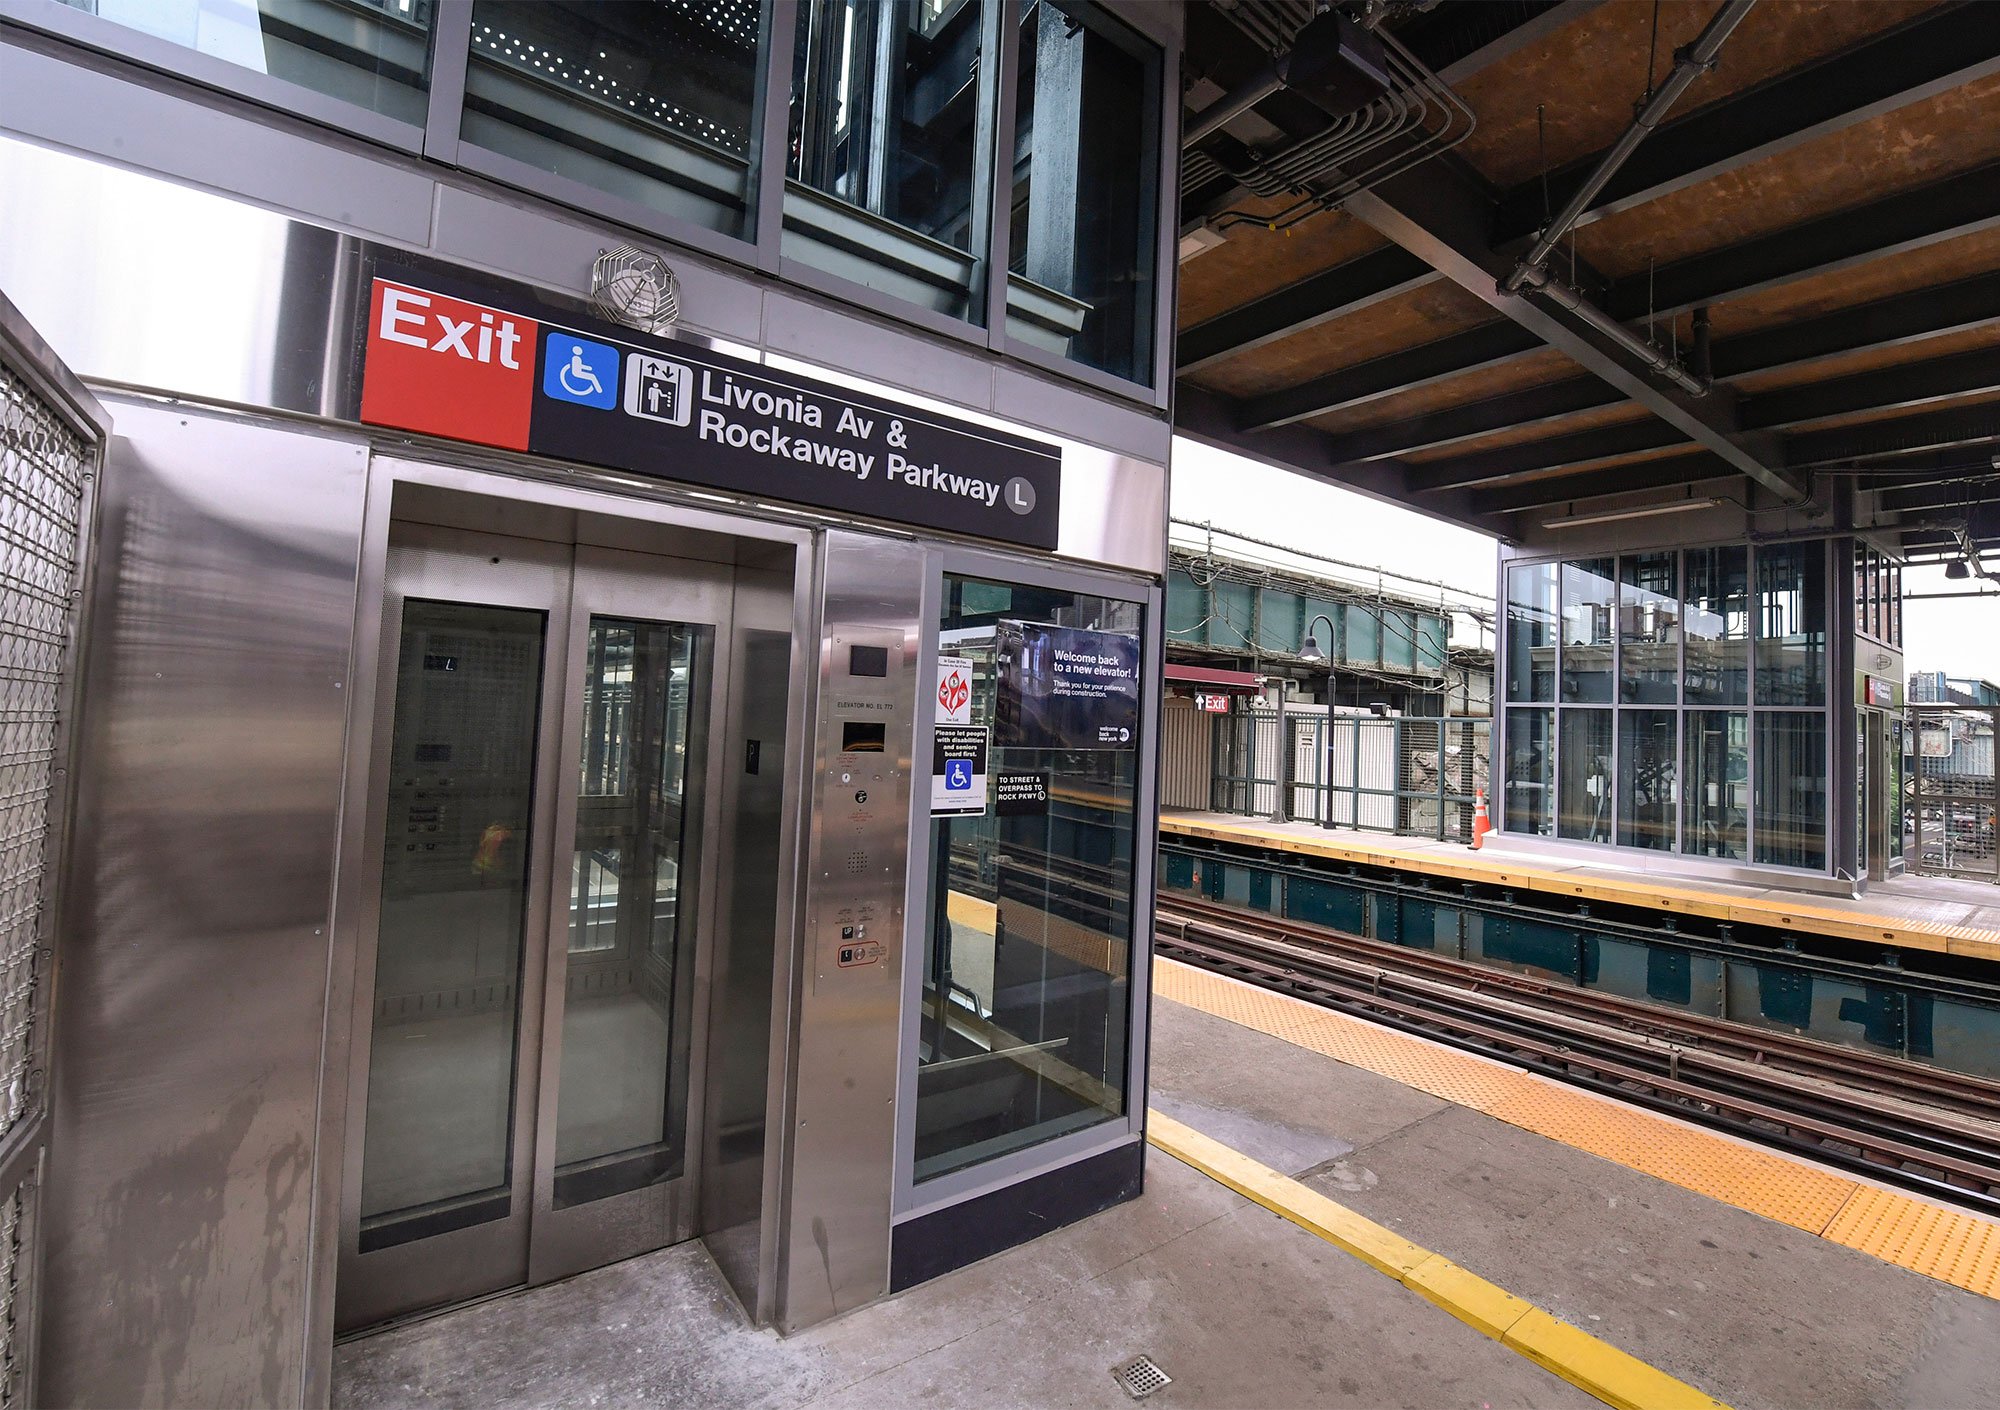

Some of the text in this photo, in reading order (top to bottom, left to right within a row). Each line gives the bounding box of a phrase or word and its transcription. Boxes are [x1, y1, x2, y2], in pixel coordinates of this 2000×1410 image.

[380, 287, 521, 370] Exit
[702, 370, 908, 449] Livonia Av &
[699, 409, 875, 480] Rockaway
[887, 453, 1000, 507] Parkway
[1054, 650, 1119, 666] Welcome back
[1054, 662, 1064, 672] to
[1073, 666, 1092, 675] new
[1094, 666, 1131, 678] elevator!
[1052, 680, 1070, 688] Thank
[1104, 684, 1126, 692] patience
[1053, 688, 1107, 698] during construction.
[1206, 695, 1226, 709] Exit
[998, 793, 1017, 801] ROCK
